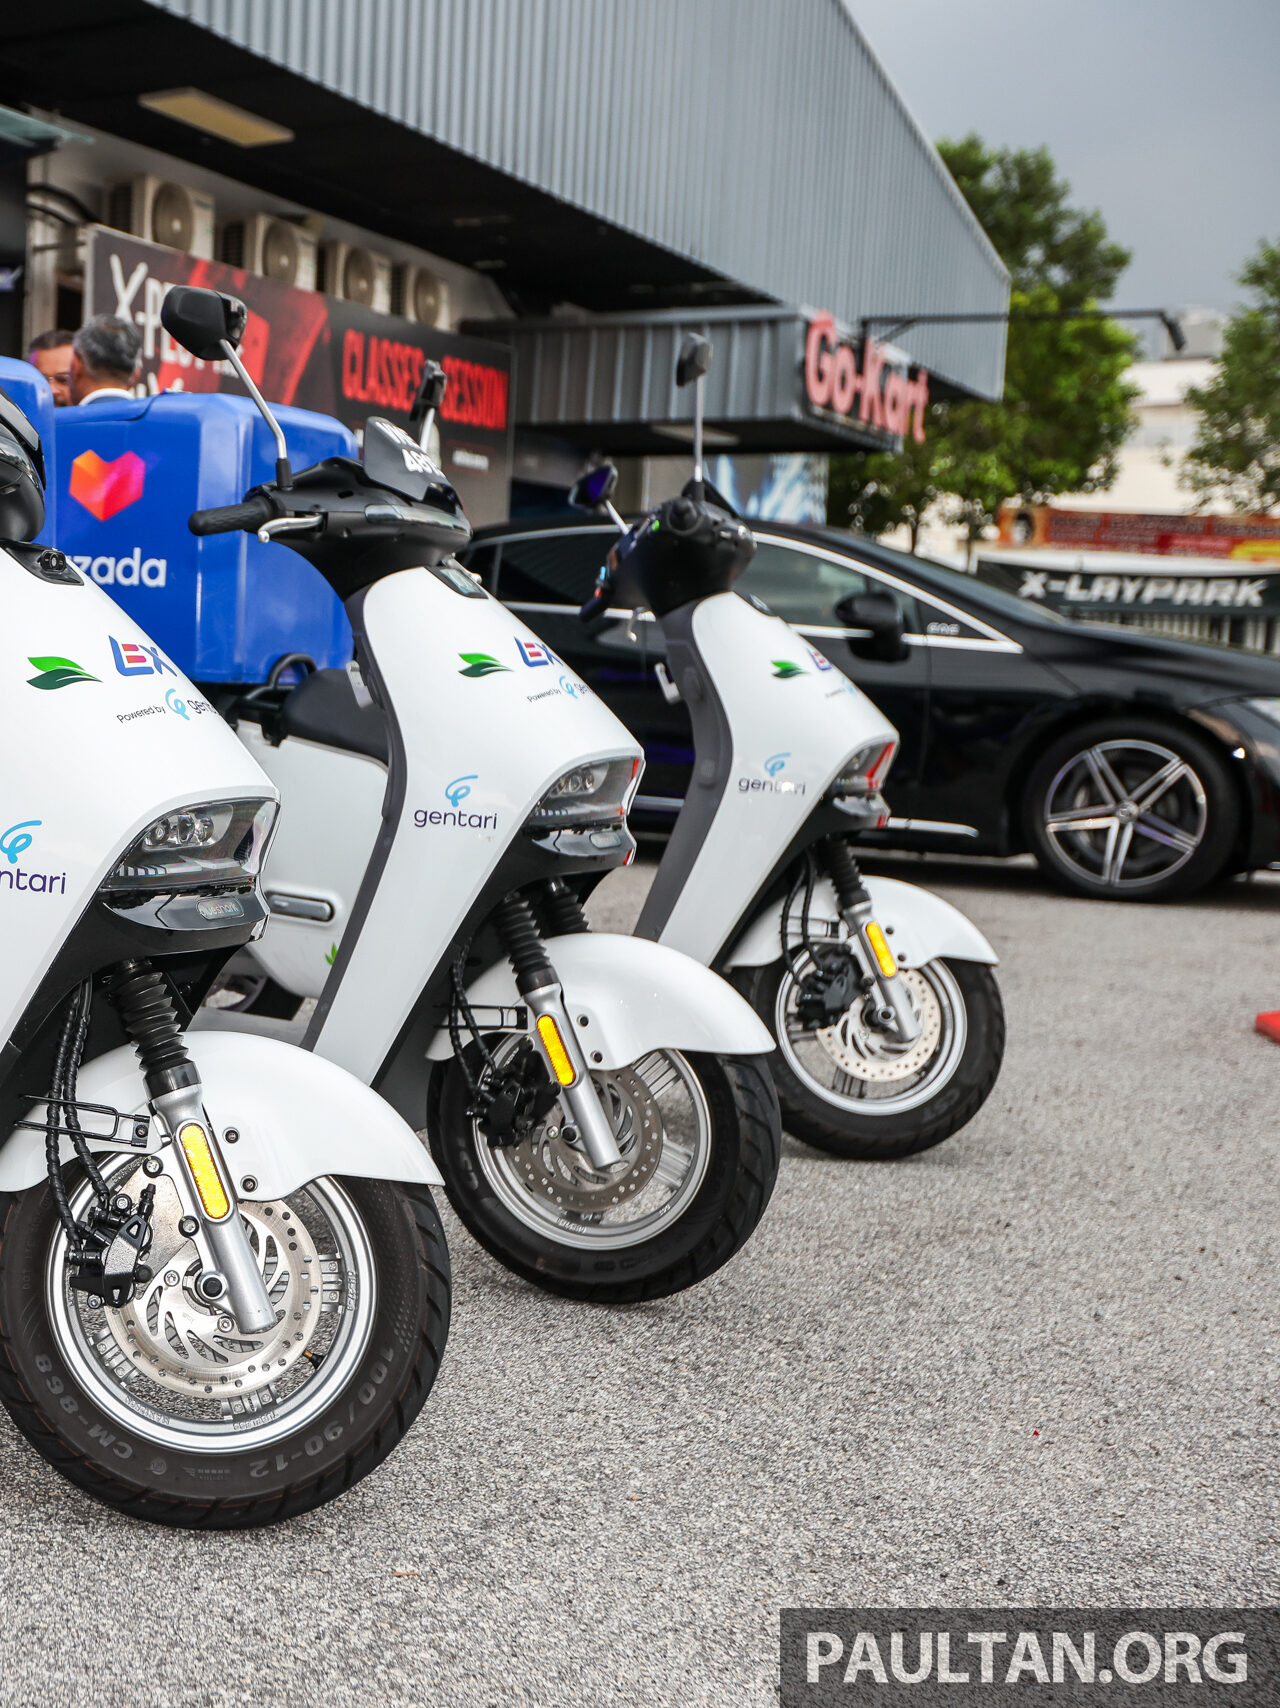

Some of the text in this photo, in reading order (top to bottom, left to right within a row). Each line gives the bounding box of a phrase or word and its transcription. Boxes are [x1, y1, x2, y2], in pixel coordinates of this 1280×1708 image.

[805, 309, 929, 445] Go-Kart
[66, 547, 167, 588] zada
[1019, 570, 1267, 607] X-LAYPARK
[108, 634, 177, 677] LEX
[116, 707, 154, 723] Powered
[153, 705, 166, 714] by
[738, 777, 806, 795] gentri
[414, 809, 497, 829] gentari
[35, 1352, 133, 1459] CM-868
